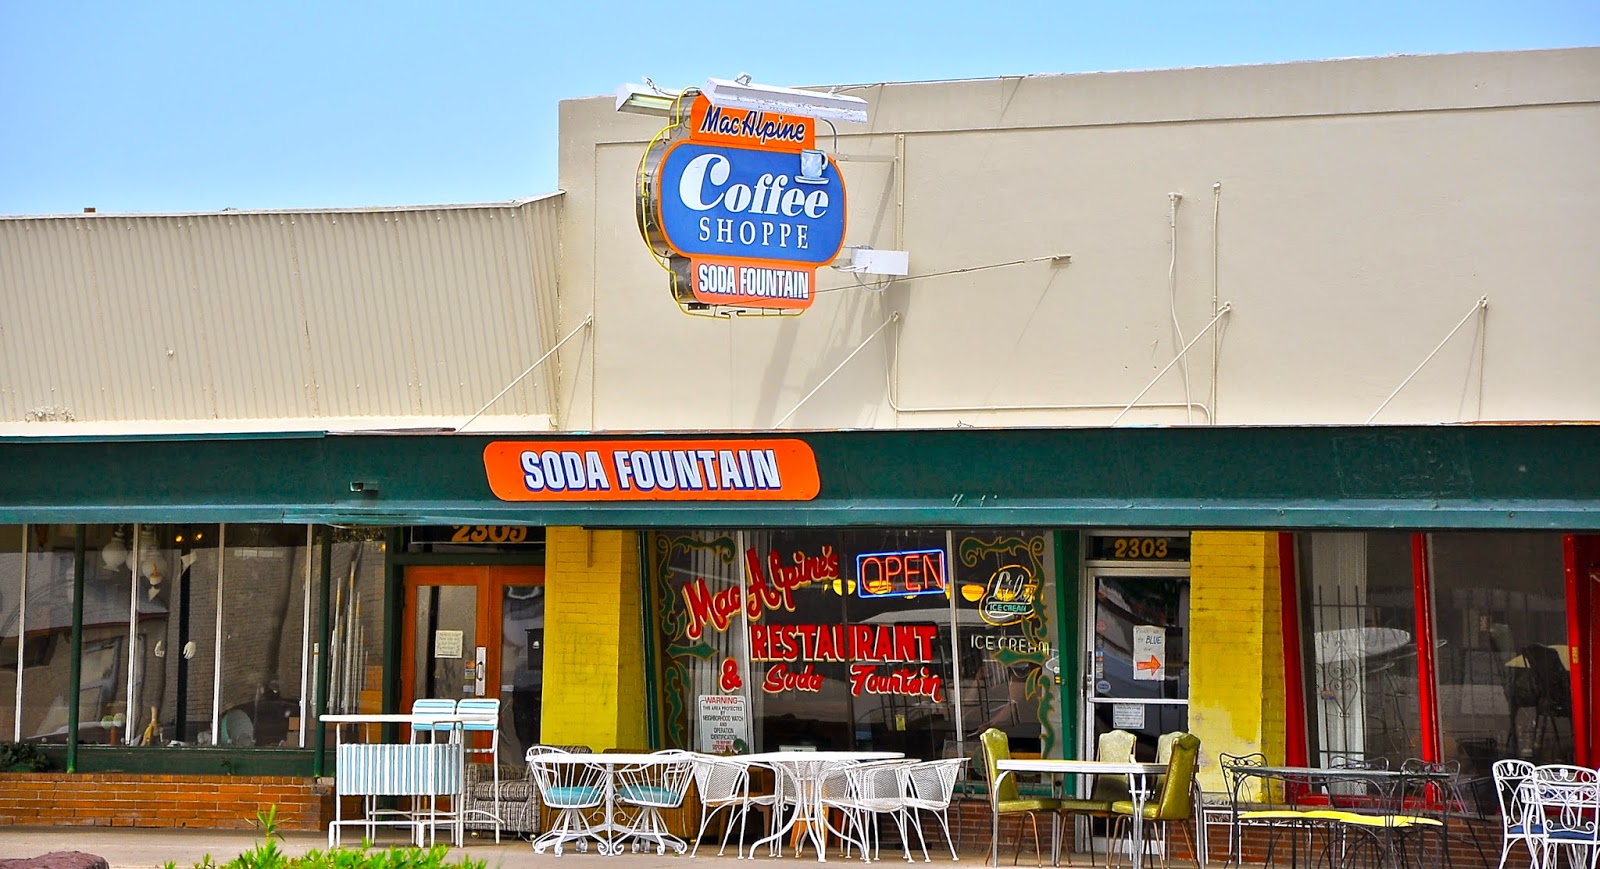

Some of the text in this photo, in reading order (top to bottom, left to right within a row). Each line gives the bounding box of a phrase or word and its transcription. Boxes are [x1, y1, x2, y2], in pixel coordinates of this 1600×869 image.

[679, 153, 829, 219] Coffee
[699, 217, 808, 249] SHOPPE
[698, 263, 809, 300] SODA FOUNTAIN
[521, 449, 781, 491] SODA FOUNTAIN
[1114, 538, 1168, 558] 2303
[862, 553, 943, 593] OPEN
[749, 624, 937, 663] RESTAURANT
[971, 634, 995, 650] ICE
[1145, 635, 1162, 645] BLUE
[720, 657, 743, 693] &
[762, 663, 944, 703] Soda Fountain
